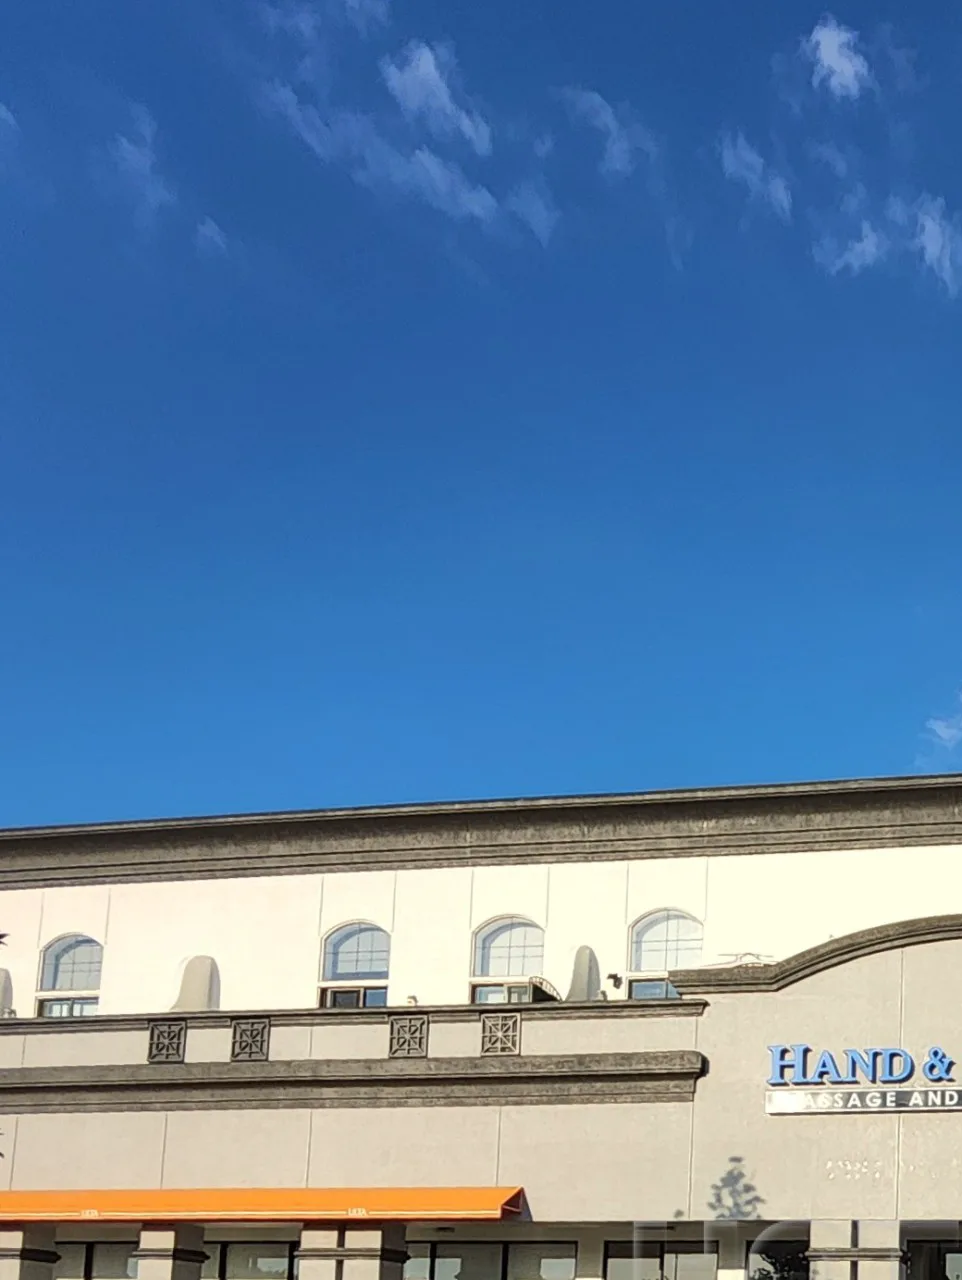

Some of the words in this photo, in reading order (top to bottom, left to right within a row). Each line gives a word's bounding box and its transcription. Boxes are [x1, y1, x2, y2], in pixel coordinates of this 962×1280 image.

[767, 1044, 915, 1086] HAND
[922, 1046, 956, 1081] &
[908, 1090, 958, 1107] AND
